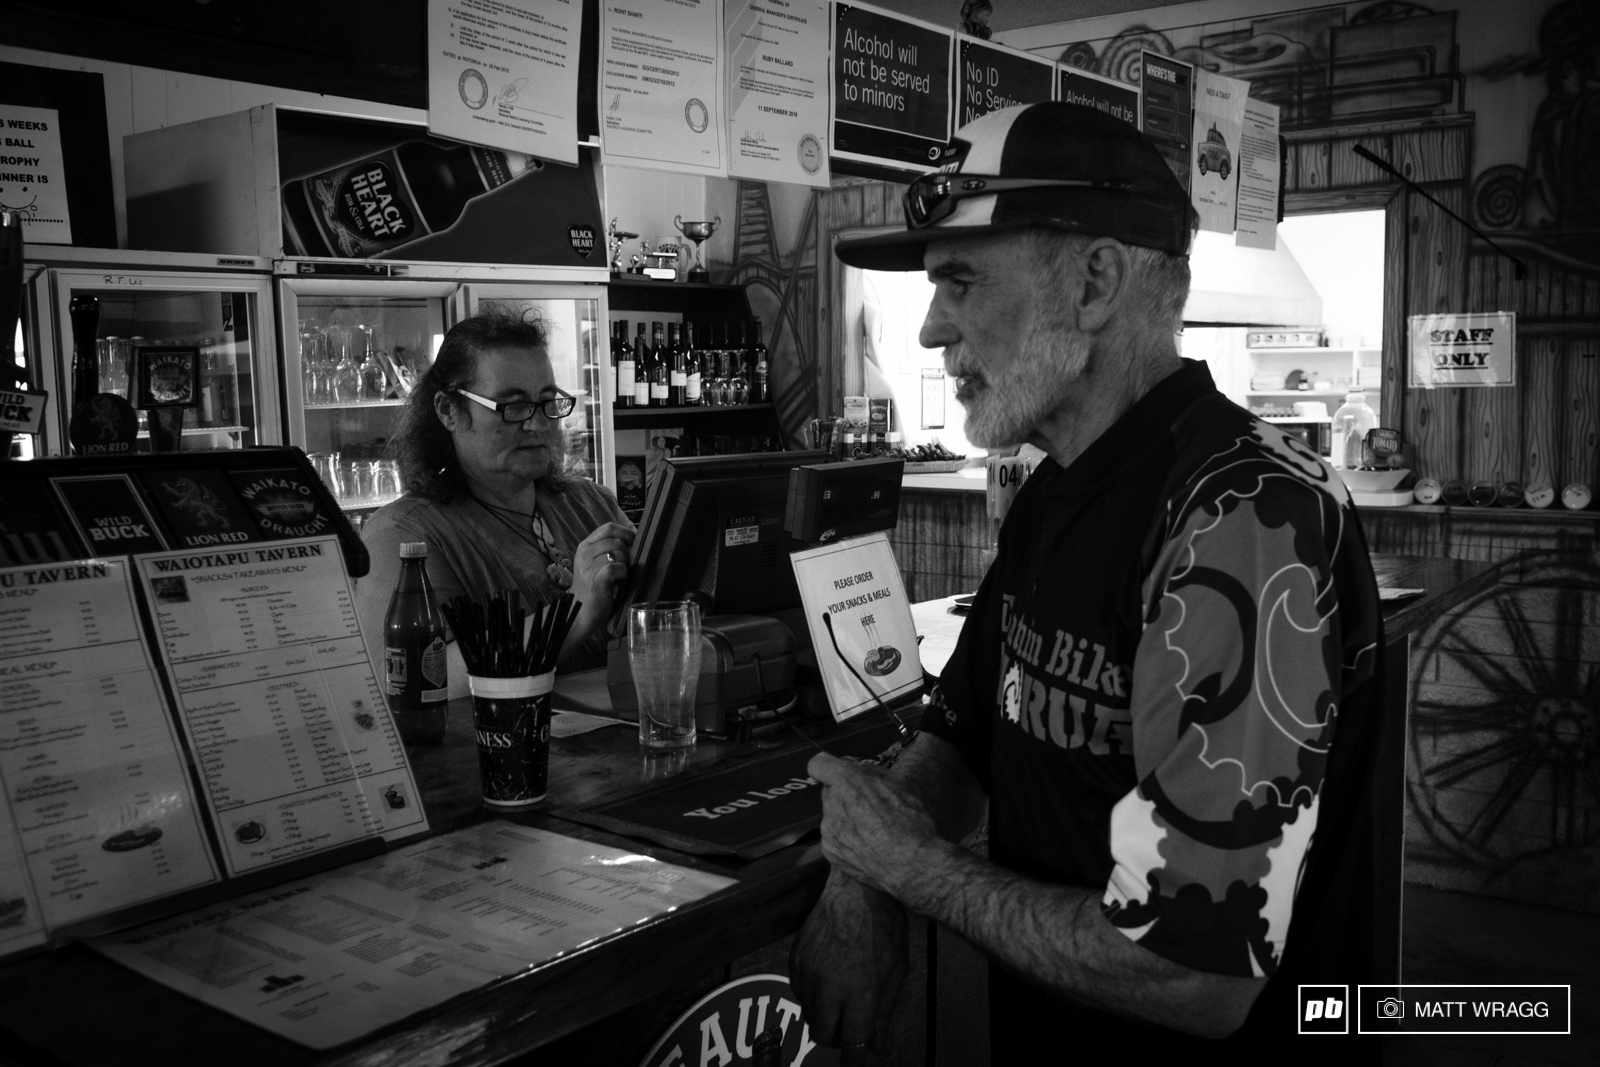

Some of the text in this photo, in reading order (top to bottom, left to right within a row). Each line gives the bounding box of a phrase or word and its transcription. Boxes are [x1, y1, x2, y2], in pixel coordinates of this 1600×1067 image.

[843, 28, 918, 67] Alcohol will
[775, 57, 793, 67] BALLARD
[843, 57, 930, 94] not be served
[966, 62, 999, 87] No ID
[1147, 63, 1167, 82] WHERE'S
[1167, 70, 1176, 83] THE
[844, 79, 905, 112] to minors
[966, 85, 983, 105] No
[1207, 88, 1215, 97] NEED
[764, 106, 788, 115] SEPTEMBER
[1066, 90, 1133, 123] Alcohol will not be
[965, 106, 982, 125] No
[7, 120, 48, 131] WEEKS
[5, 138, 34, 148] BALL
[38, 175, 48, 183] IS
[350, 173, 390, 237] HEART
[367, 168, 406, 234] BLACK
[354, 216, 365, 231] COLA
[570, 229, 593, 239] BLACK
[572, 238, 593, 248] HEART
[1430, 328, 1494, 343] STAFF
[149, 355, 191, 371] WAIKATO
[1434, 352, 1490, 367] ONLY
[0, 406, 33, 422] CK
[83, 442, 129, 455] LION RED
[1373, 436, 1397, 452] TOMATO
[242, 478, 310, 499] WAIKATO
[93, 516, 132, 527] WILD
[260, 514, 328, 536] DRAUGHT
[761, 517, 780, 525] CASIO
[89, 524, 150, 542] BUCK
[185, 531, 249, 547] LION RED
[154, 544, 322, 573] WAIOTAPU TAVERN
[23, 564, 106, 585] TAVERN
[833, 571, 874, 590] PLEASE ORDER
[827, 587, 891, 615] YOUR SNACKS & MEALS
[860, 614, 876, 627] HERE
[683, 776, 818, 820] You look
